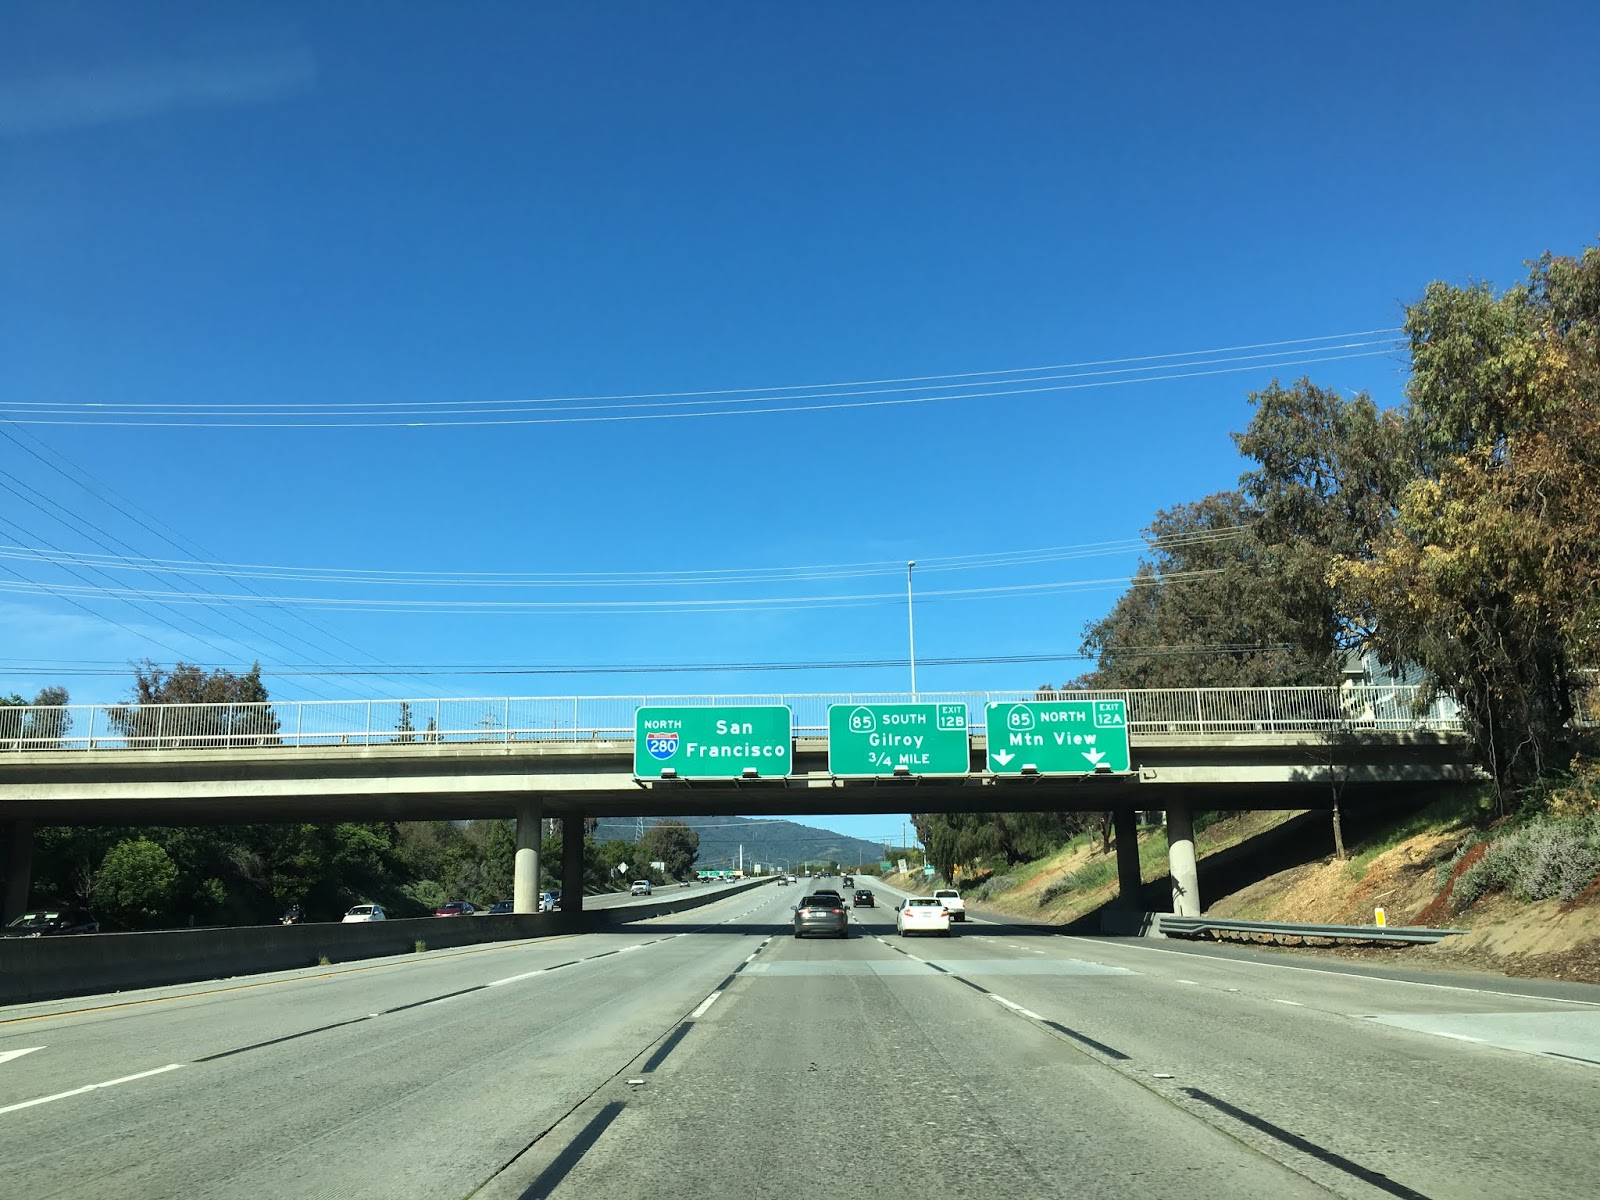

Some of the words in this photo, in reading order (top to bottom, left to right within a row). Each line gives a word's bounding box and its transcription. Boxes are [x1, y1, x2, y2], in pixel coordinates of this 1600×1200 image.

[942, 706, 962, 714] EXIT
[1099, 703, 1120, 712] EXIT
[644, 720, 682, 729] NORTH
[852, 716, 872, 729] 85
[882, 714, 927, 725] SOUTH
[940, 716, 965, 727] 12B
[1011, 713, 1031, 726] 85
[1040, 711, 1087, 722] NORTH
[1098, 713, 1122, 724] 12A
[716, 720, 753, 735] San
[869, 733, 924, 749] Gilroy
[1009, 732, 1044, 746] Mtn
[1053, 731, 1097, 745] View
[650, 740, 676, 753] 280
[686, 742, 785, 757] Francisco
[868, 752, 893, 767] 3/4
[899, 753, 930, 764] MILE
